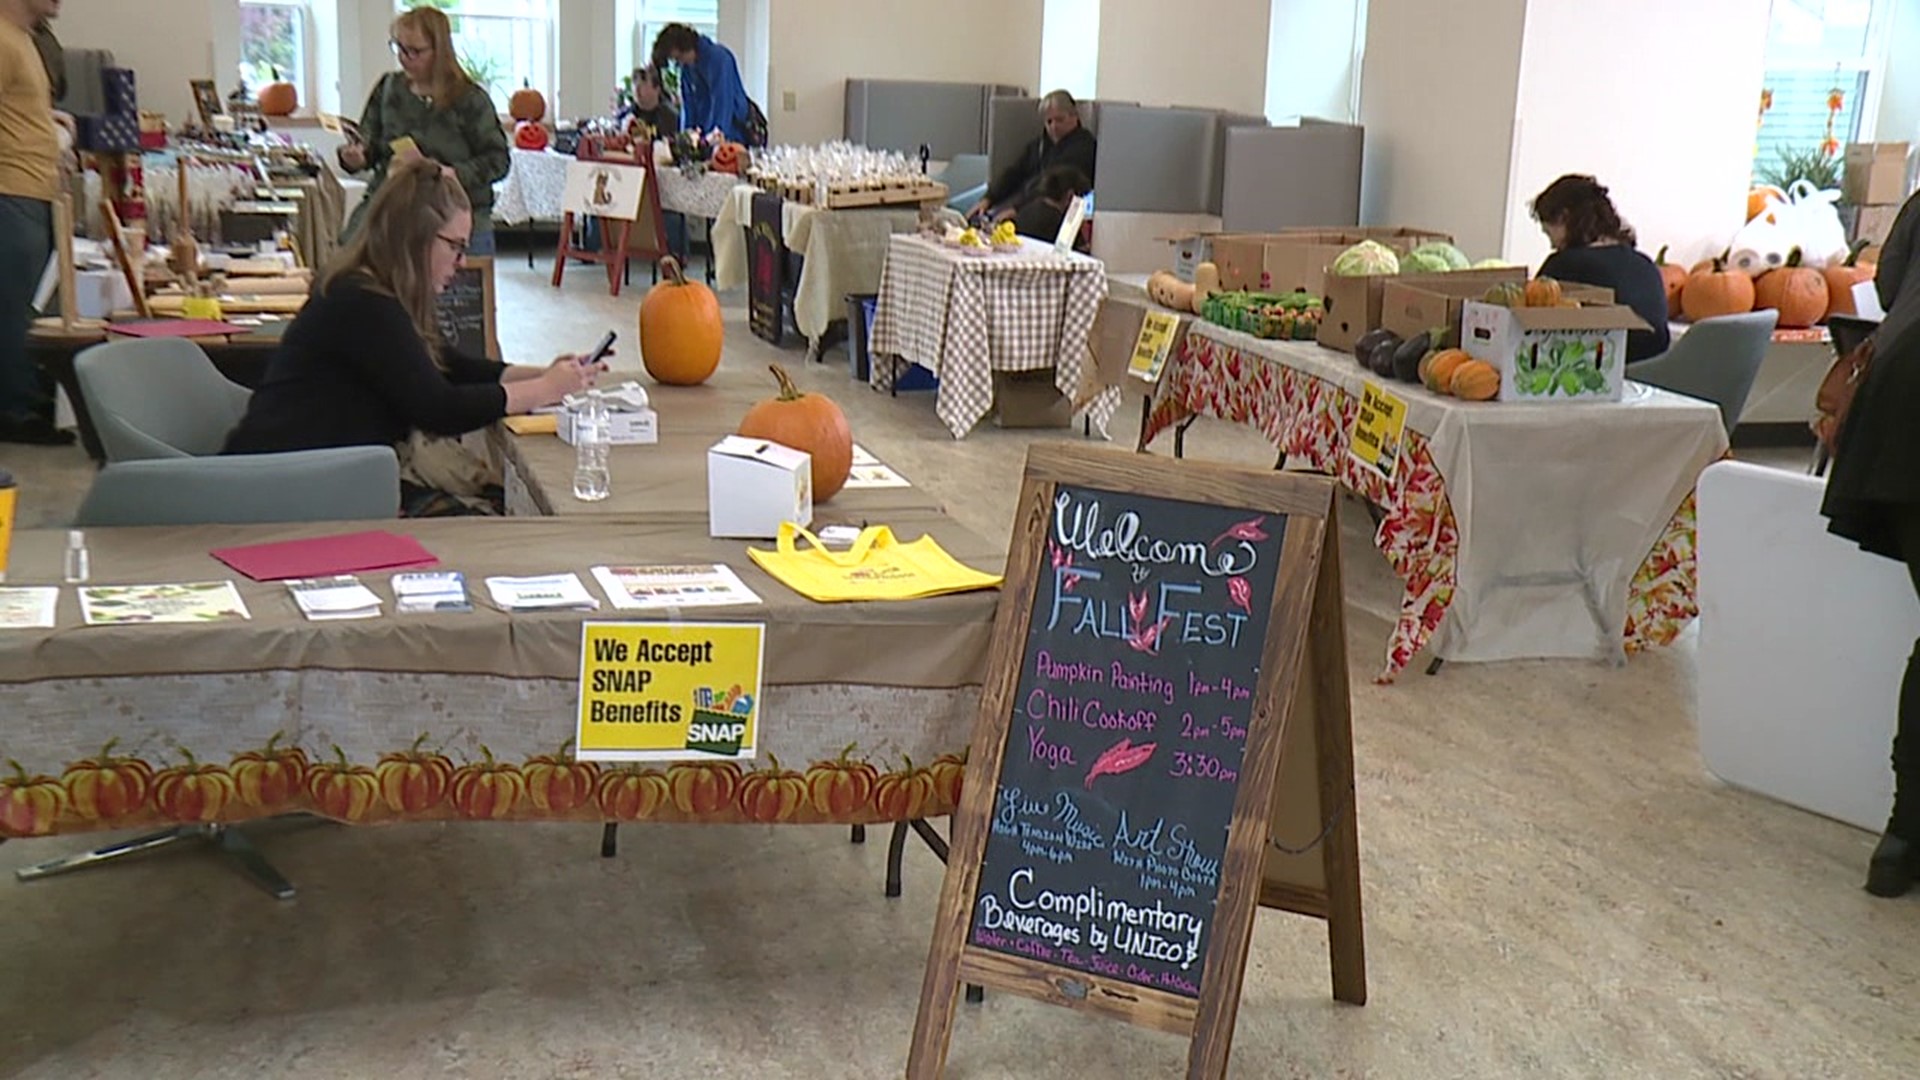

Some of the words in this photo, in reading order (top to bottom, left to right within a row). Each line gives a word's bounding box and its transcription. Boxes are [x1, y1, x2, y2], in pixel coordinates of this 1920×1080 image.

[1054, 492, 1257, 577] Welcome
[594, 638, 628, 662] We
[636, 639, 712, 666] Accept
[592, 669, 651, 693] SNAP
[1036, 650, 1103, 686] Pumpkin
[1110, 660, 1174, 705] Painting
[590, 700, 682, 723] Benefits
[687, 722, 746, 742] SNAP
[1026, 688, 1078, 722] Chili
[1083, 700, 1157, 733] Cookoff
[1028, 724, 1078, 770] Yoga
[1168, 751, 1238, 783] 3:30pm
[1112, 809, 1165, 856] Art
[979, 894, 1081, 947] Beverages
[1089, 922, 1109, 954] by
[1009, 867, 1203, 951] Complimentary
